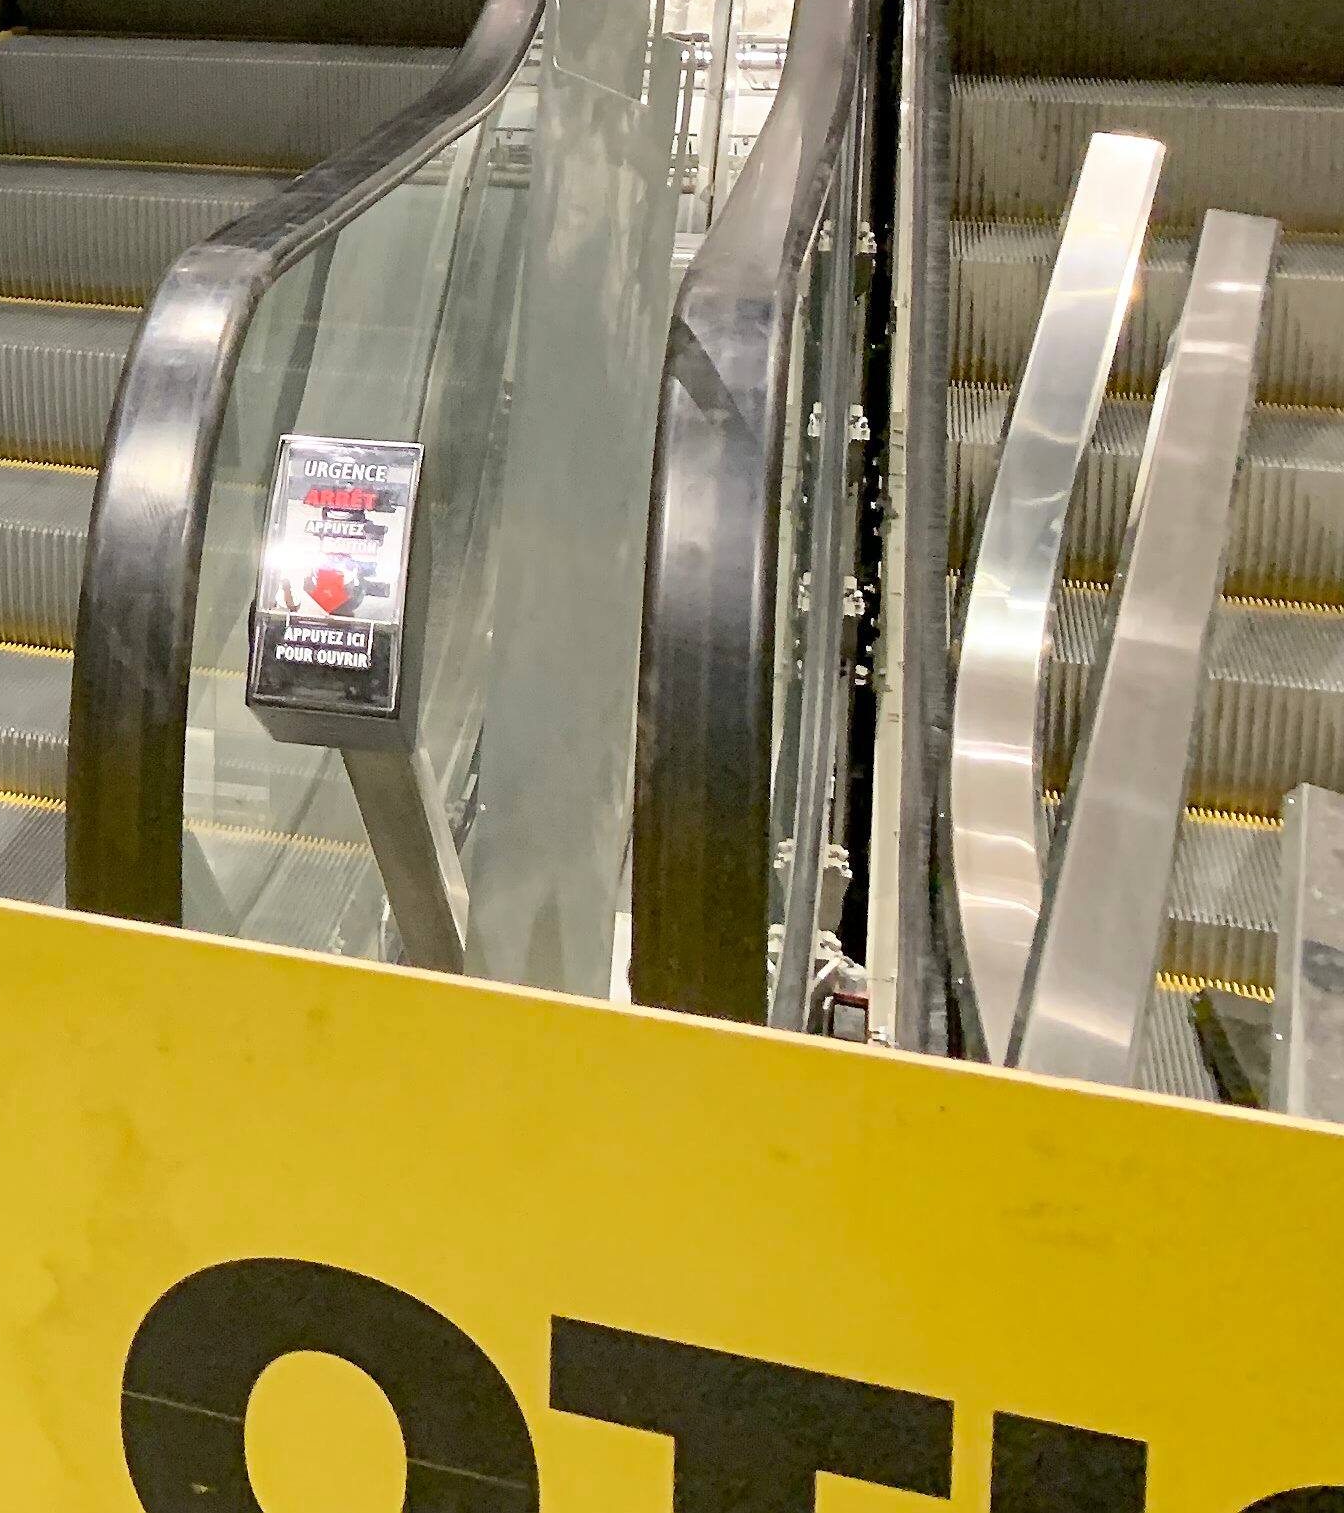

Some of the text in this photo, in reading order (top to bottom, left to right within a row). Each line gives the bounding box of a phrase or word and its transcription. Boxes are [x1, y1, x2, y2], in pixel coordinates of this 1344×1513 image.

[304, 460, 388, 482] URGENCE
[305, 521, 365, 537] APPUYEZ
[284, 628, 365, 647] APPUYEZ ICI
[276, 646, 368, 668] POUR OUVRIR
[121, 1257, 1344, 1513] OT
